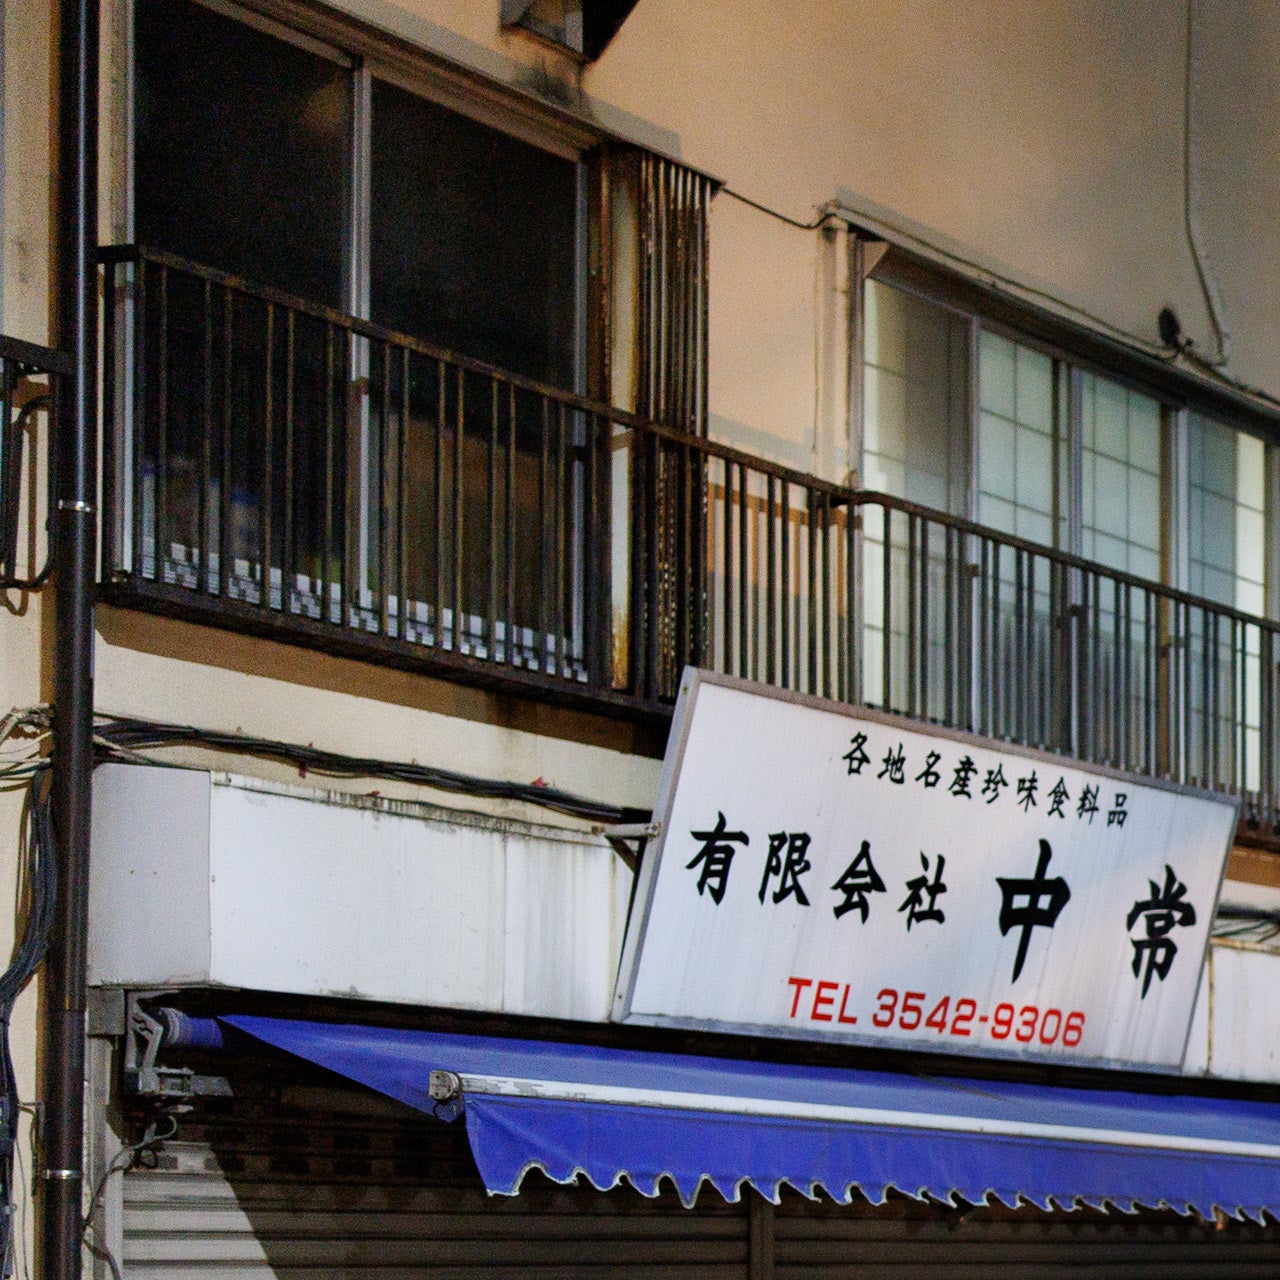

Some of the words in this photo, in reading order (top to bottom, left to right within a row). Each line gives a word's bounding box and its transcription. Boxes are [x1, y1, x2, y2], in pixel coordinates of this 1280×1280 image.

[842, 731, 1128, 827] 各地名産珍味食料品
[685, 810, 947, 931] 有限会社
[996, 838, 1198, 999] 中常
[786, 976, 858, 1024] TEL
[871, 988, 1086, 1047] 3542-9306
